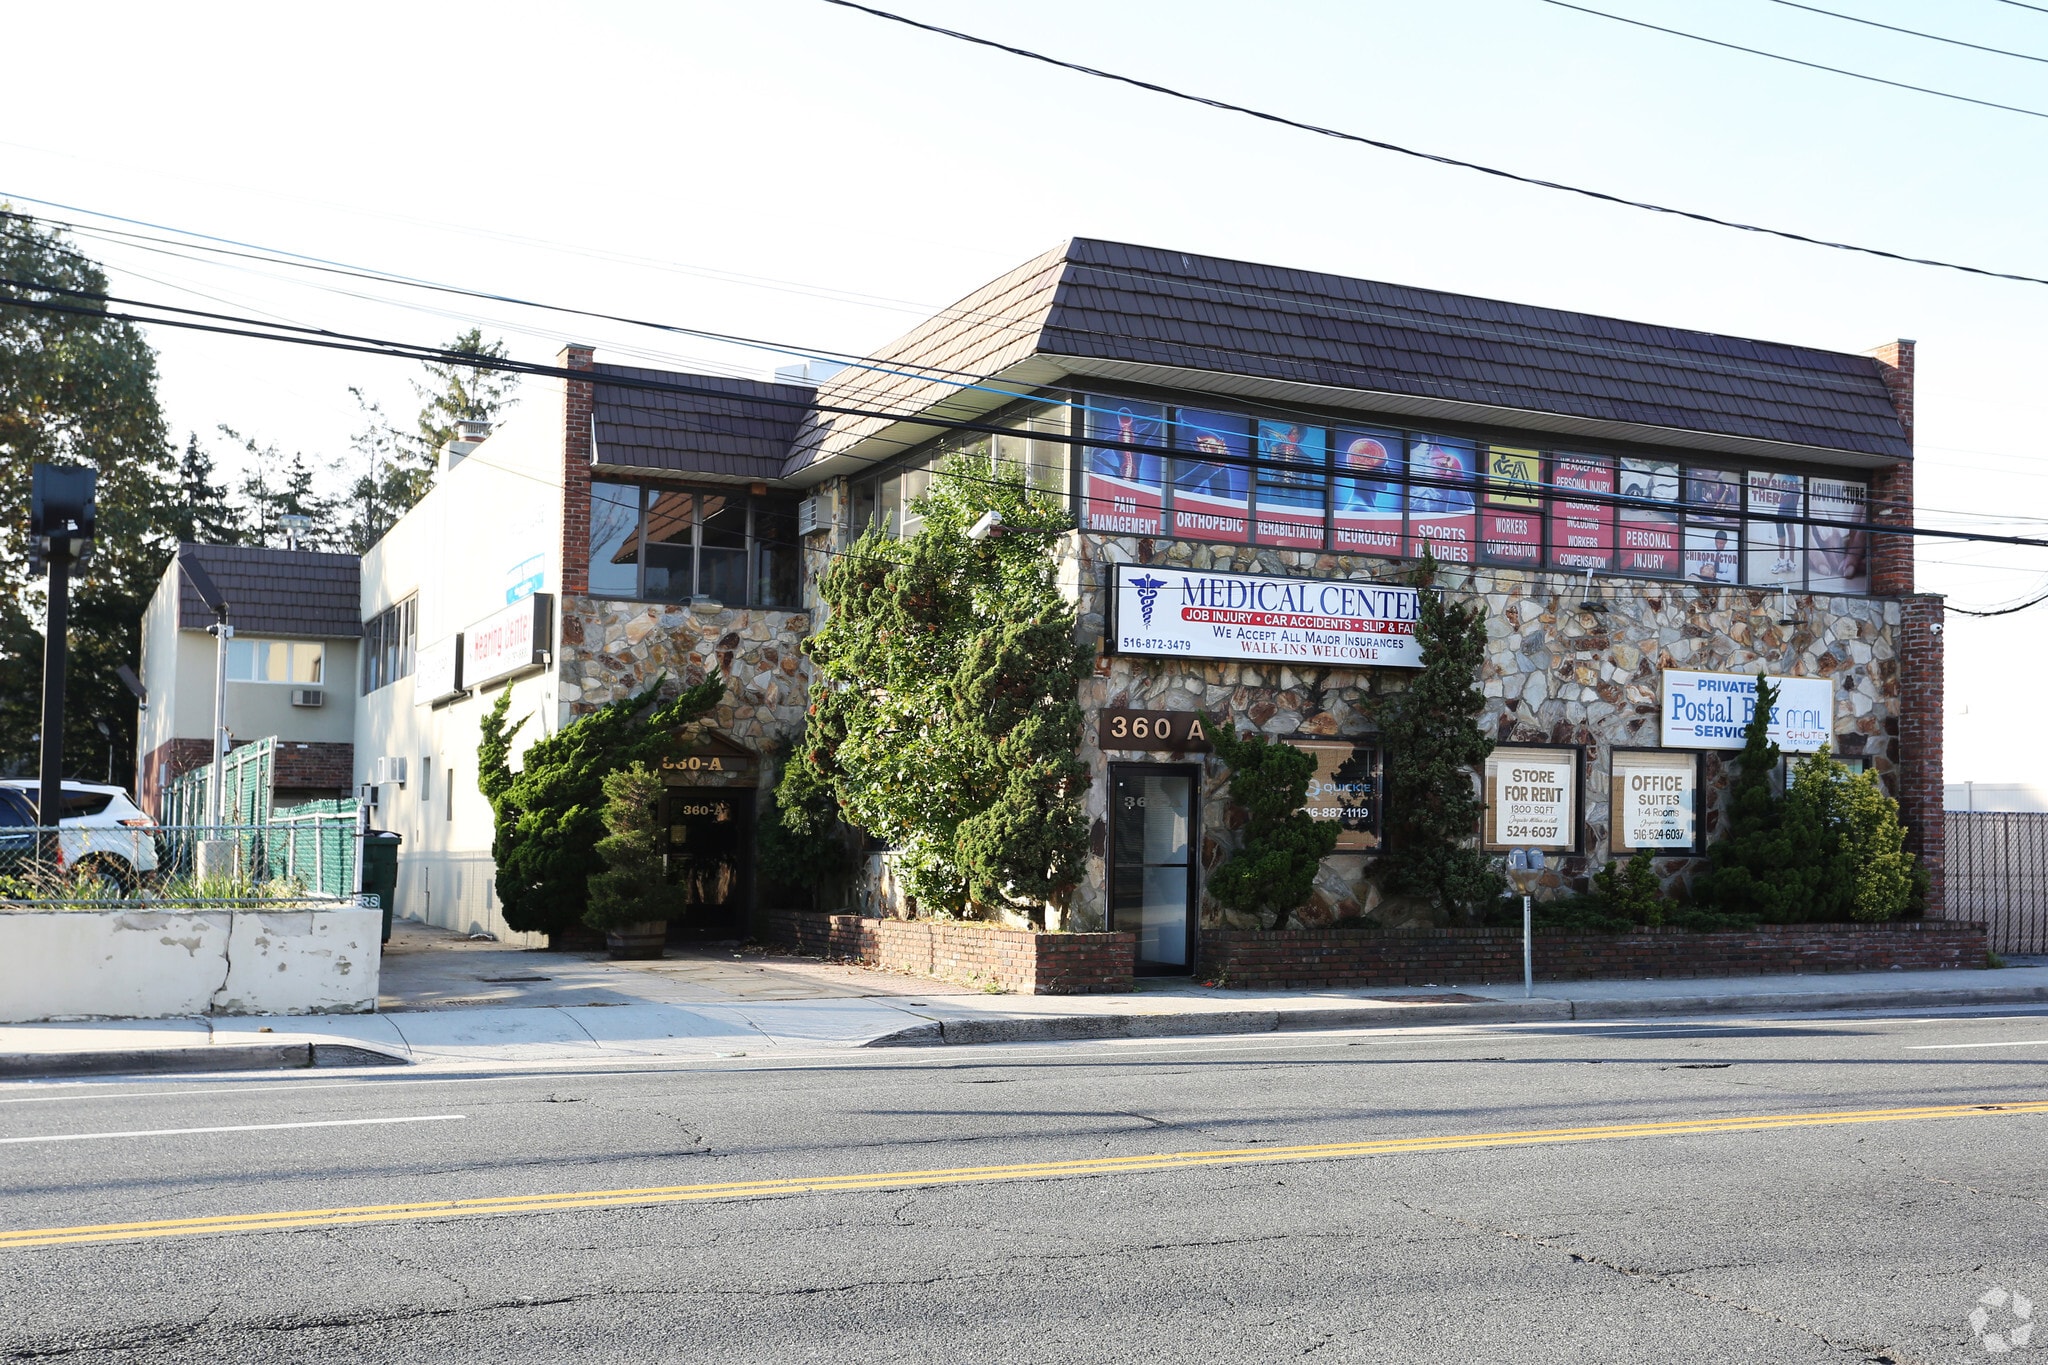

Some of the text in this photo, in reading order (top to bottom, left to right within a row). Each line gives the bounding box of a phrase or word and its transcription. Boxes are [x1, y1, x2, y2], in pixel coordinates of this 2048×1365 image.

[1556, 476, 1610, 493] PERSONAL INJURY
[1114, 496, 1136, 514] PAIN
[1752, 488, 1786, 506] THER
[1092, 514, 1157, 534] MANAGEMENT
[1177, 512, 1243, 532] ORTHOPEDIC
[1258, 519, 1324, 540] REHABILITATION
[1496, 518, 1528, 535] WORKERS
[1567, 516, 1599, 530] INCLUDING
[1338, 526, 1398, 547] NEUROLOGY
[1418, 524, 1466, 545] SPORTS
[1568, 535, 1598, 548] WORKERS
[1626, 530, 1672, 549] PERSONAL
[1486, 539, 1536, 558] COMPENSATION
[1685, 551, 1738, 564] CHIROPRACTOR
[1560, 554, 1606, 568] COMPENSATION
[1633, 552, 1664, 570] INJURY
[1180, 576, 1314, 613] MEDICAL
[1186, 609, 1210, 621] JOB
[1212, 610, 1253, 624] INJURY
[1264, 614, 1288, 626] CAR
[1290, 616, 1352, 630] ACCIDENTS
[1362, 620, 1385, 632] SLIP
[1388, 622, 1396, 633] &
[474, 627, 502, 662] Hearing
[1124, 637, 1191, 651] 516-872-3479
[1241, 640, 1378, 660] WALK-INS WELCOME
[1698, 679, 1756, 694] PRIVATE
[1672, 693, 1780, 725] Postal Bx
[1111, 716, 1204, 741] 360 A
[1786, 709, 1825, 730] MAIL
[1694, 725, 1746, 739] SERVIC
[1786, 730, 1825, 740] CHUTE
[1512, 768, 1555, 784] STORE
[1632, 774, 1682, 792] OFFICE
[1504, 786, 1564, 802] FOR RENT
[1638, 794, 1680, 806] SUITES
[683, 805, 724, 816] 360-A
[1511, 804, 1532, 814] 1300
[1506, 826, 1558, 838] 524-6037
[1634, 828, 1684, 840] 516-524-6037
